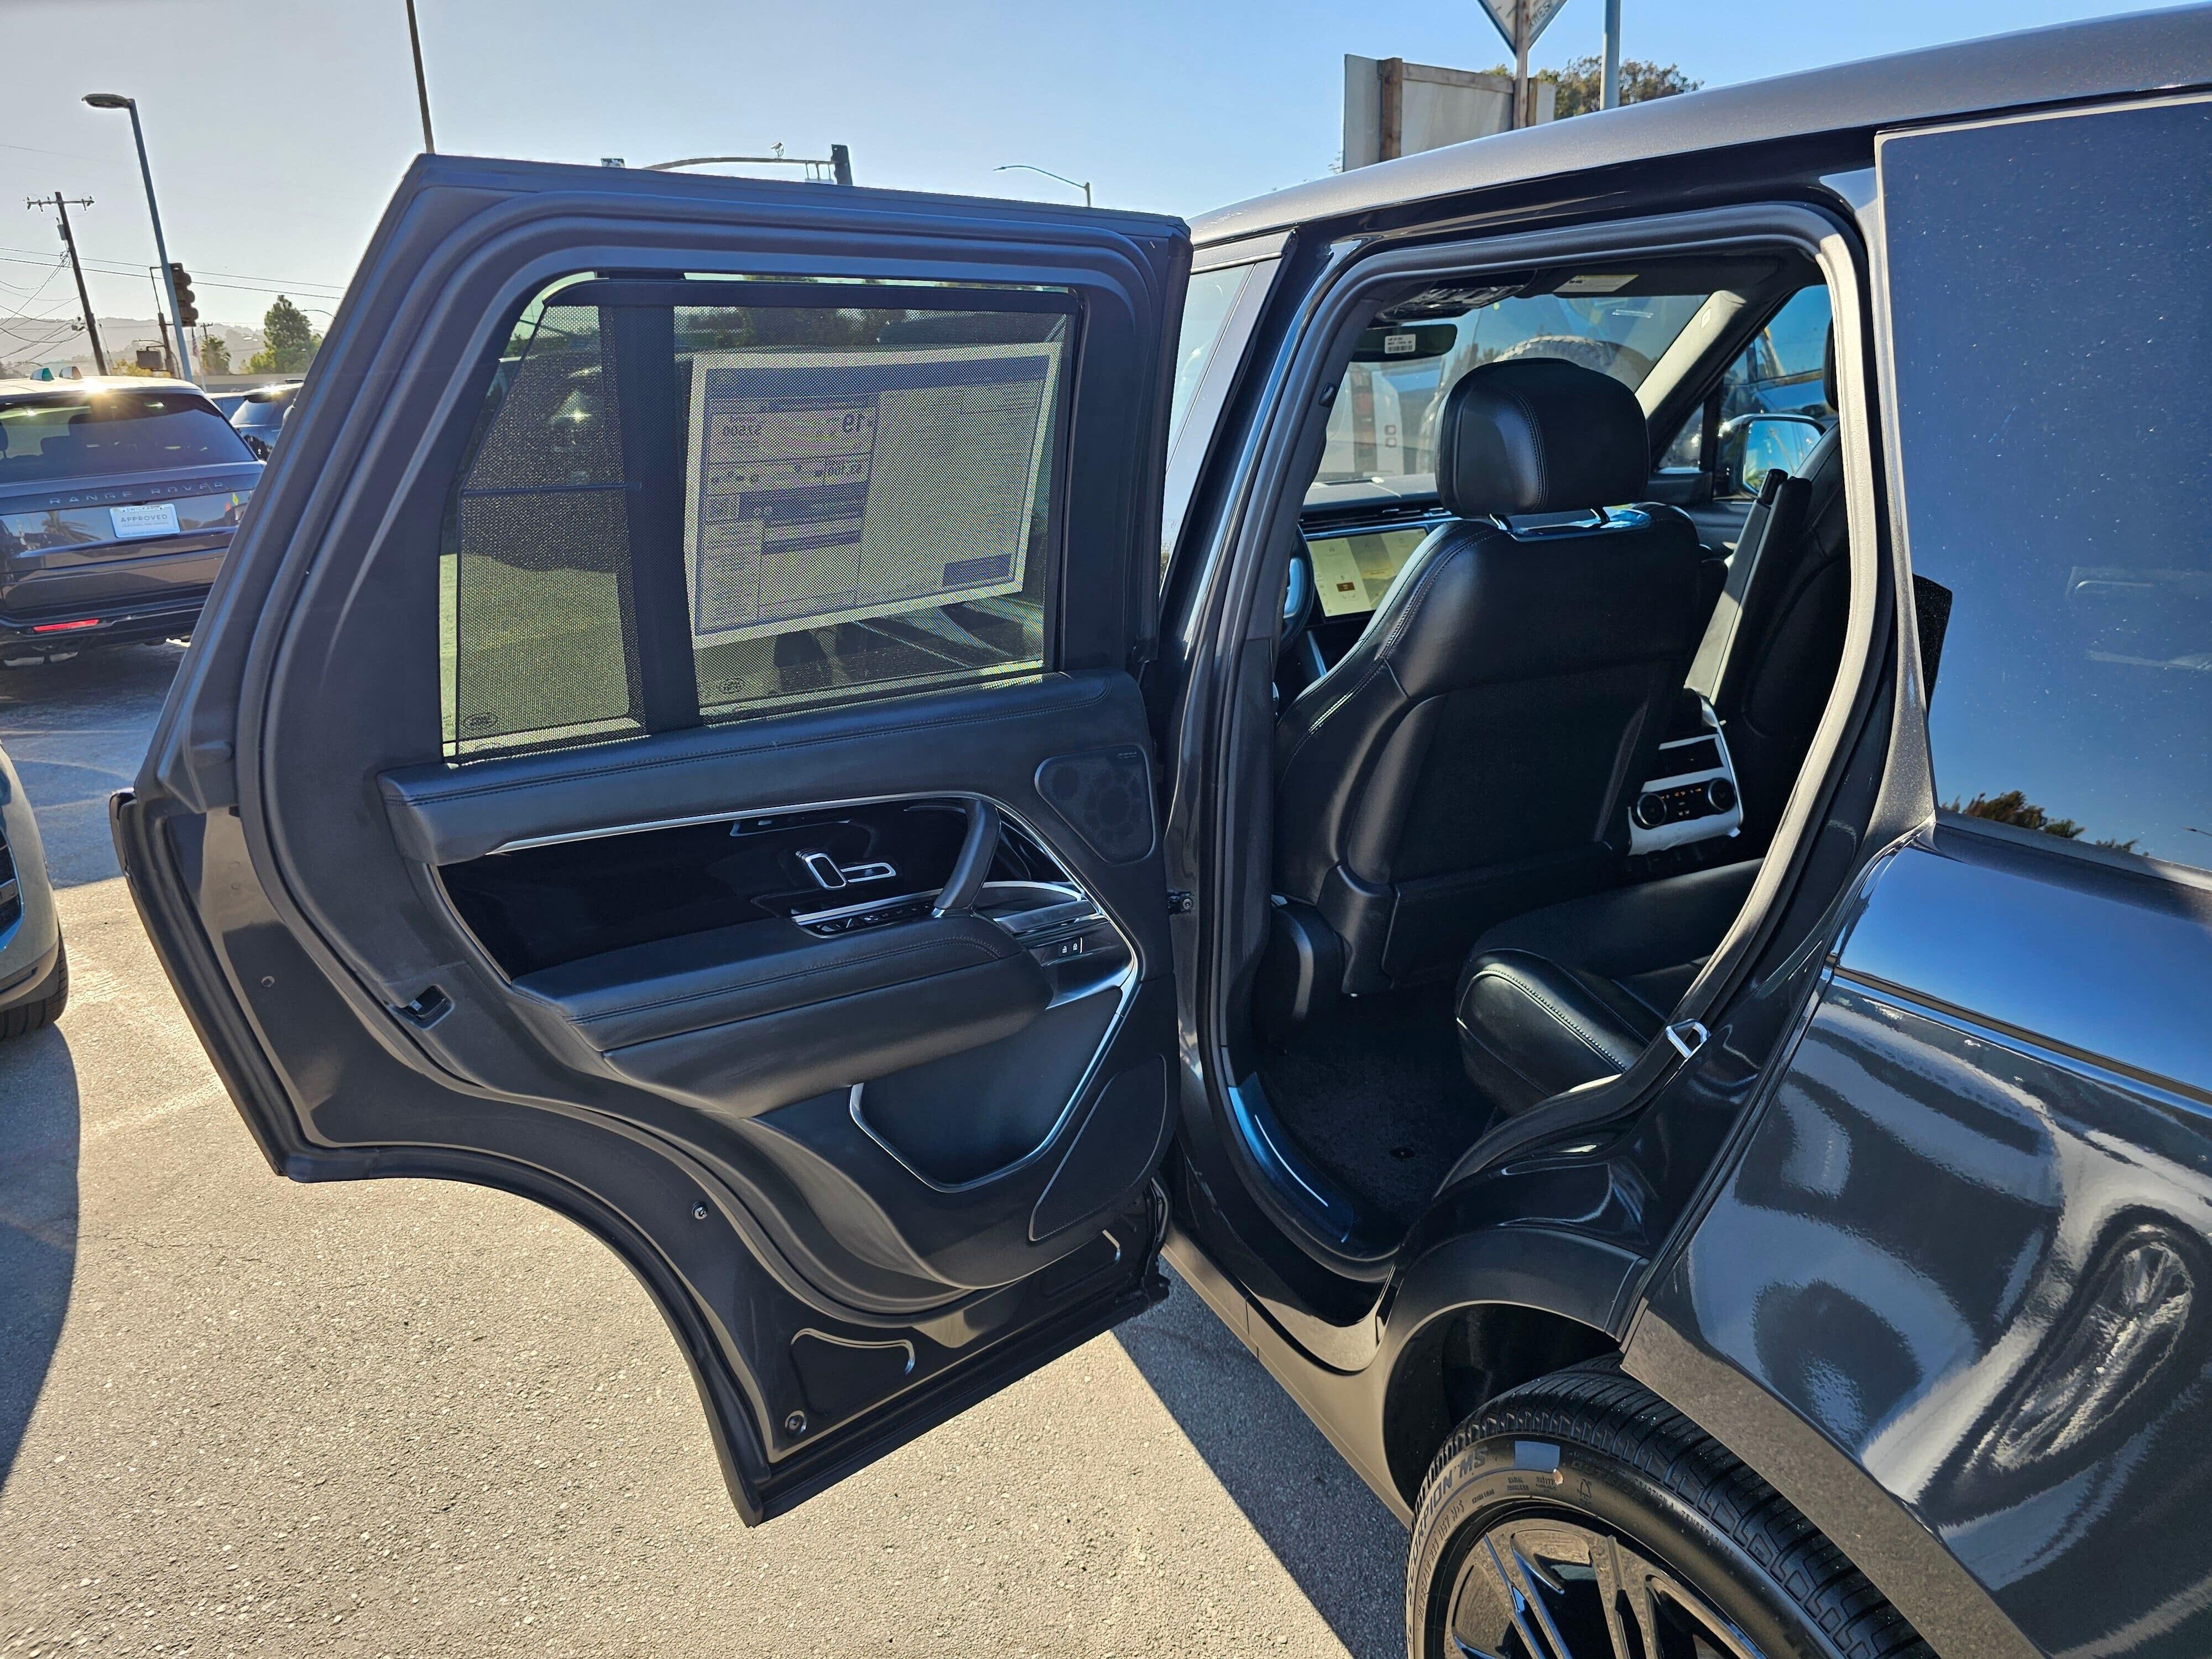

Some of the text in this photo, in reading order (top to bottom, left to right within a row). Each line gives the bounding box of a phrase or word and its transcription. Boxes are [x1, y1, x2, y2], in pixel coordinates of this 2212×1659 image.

[49, 482, 223, 504] RANGE ROVER
[121, 514, 168, 523] APPROVED
[1408, 1469, 1453, 1606] SCORPION
